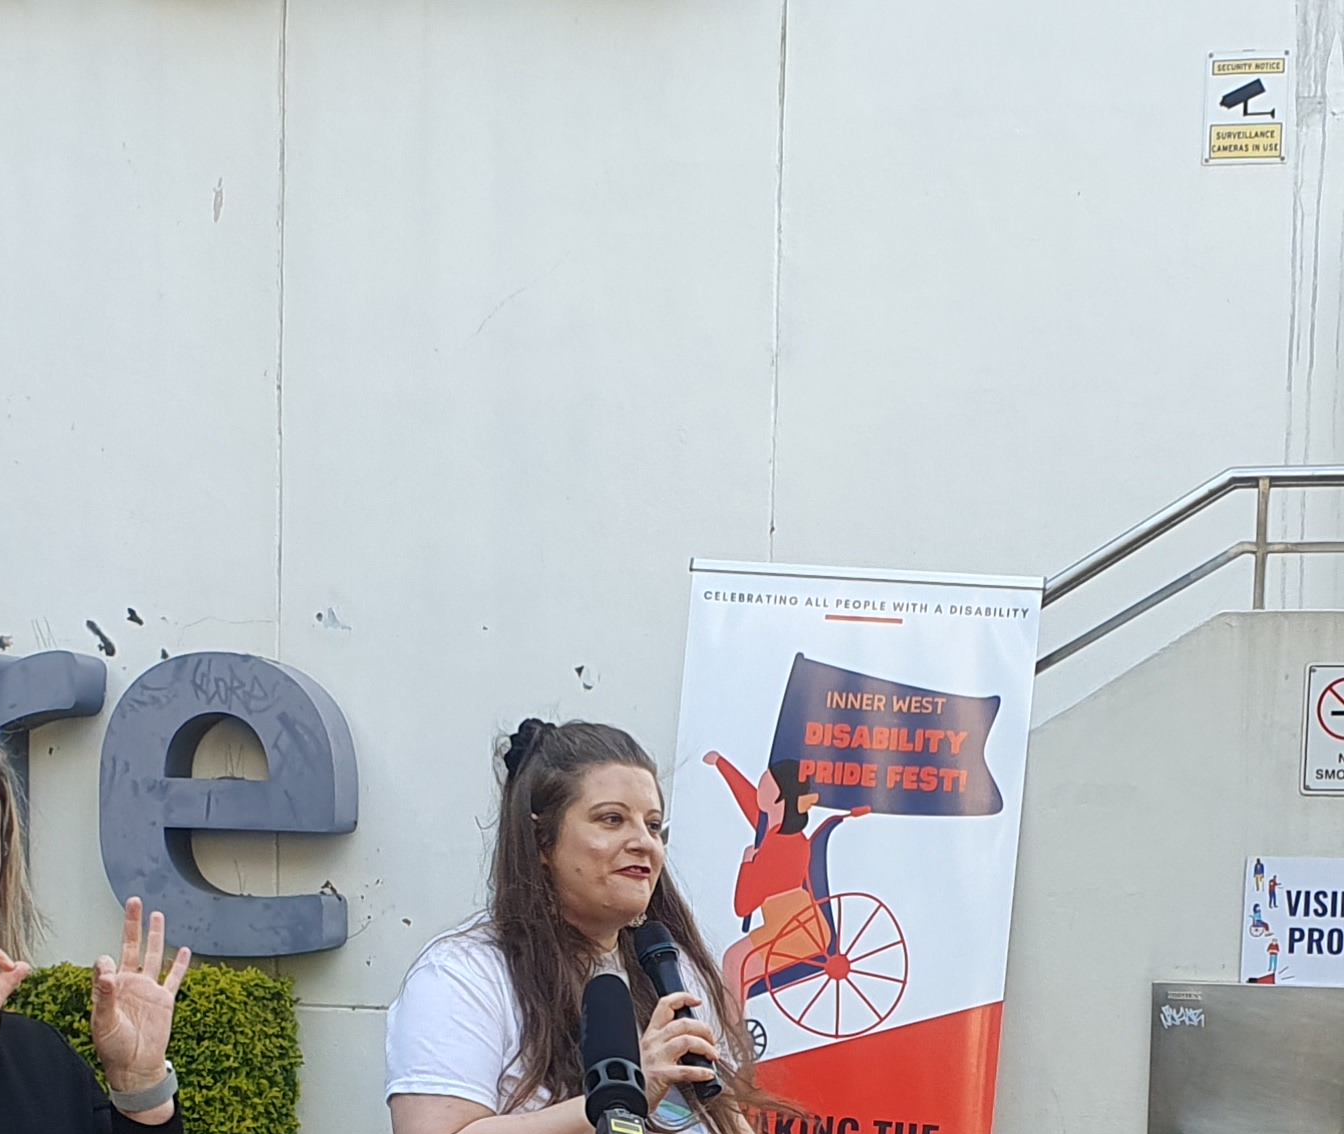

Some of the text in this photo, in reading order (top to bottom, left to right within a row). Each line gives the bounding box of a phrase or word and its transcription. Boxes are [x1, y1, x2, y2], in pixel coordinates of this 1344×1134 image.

[1217, 62, 1280, 71] SECURITY NOTICE
[1216, 130, 1275, 140] SURVEILLANCE
[1212, 144, 1248, 152] CAMERAS
[703, 591, 1030, 619] CELEBRATING ALL PEOPLE WITH A DISABILITY
[826, 691, 946, 716] INNER WEST
[805, 722, 967, 756] DISABILITY
[798, 759, 968, 793] PRIDE FEST!
